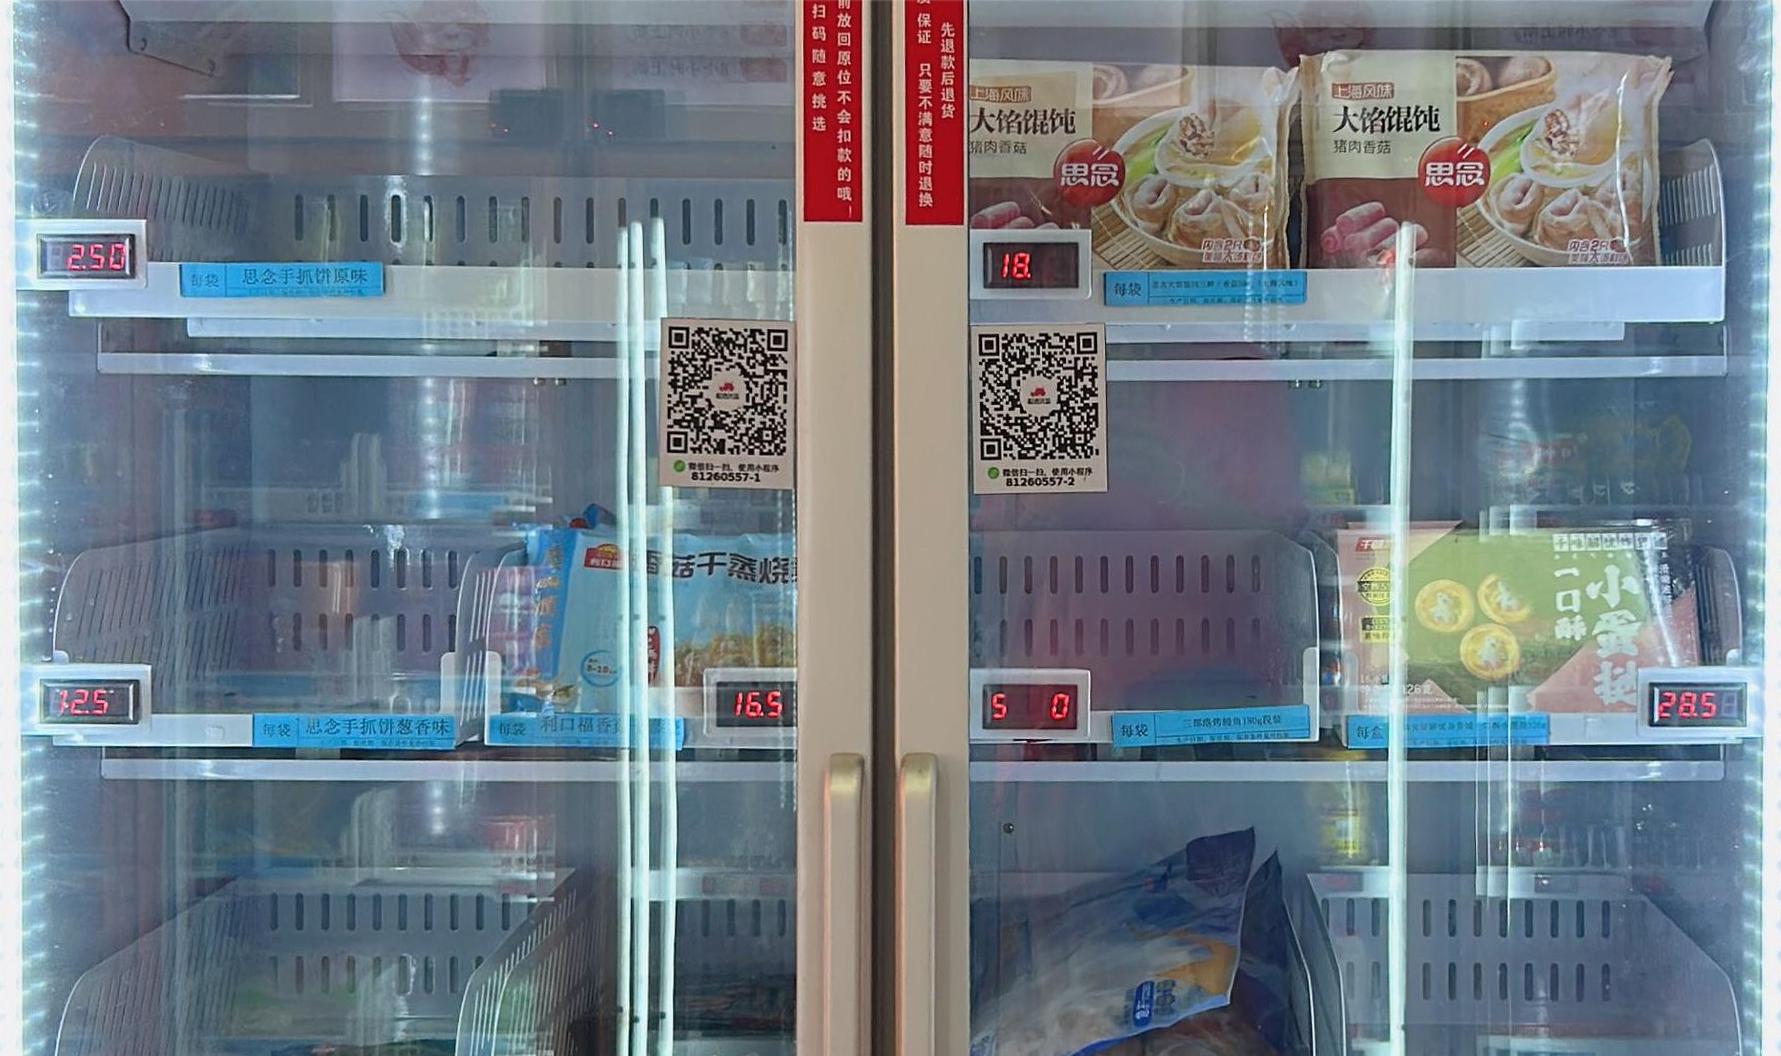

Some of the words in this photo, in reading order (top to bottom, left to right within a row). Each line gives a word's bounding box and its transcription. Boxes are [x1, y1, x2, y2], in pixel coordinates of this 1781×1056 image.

[812, 4, 827, 131] 扫码随意挑选
[940, 22, 956, 119] 先退款后退货
[1332, 83, 1395, 100] 上海风味
[969, 107, 1077, 136] 大馅馄饨
[1332, 105, 1441, 134] 大馅馄饨
[1333, 139, 1392, 155] 猪肉香菇
[1060, 163, 1120, 187] 思念
[1424, 161, 1486, 188] 思念
[242, 267, 369, 286] 思念手抓饼原味
[690, 471, 761, 483] 81260557-1
[1005, 477, 1076, 487] 81260557-2
[645, 548, 797, 584] 菇干蒸烧
[306, 718, 450, 736] 思念手抓饼葱香味
